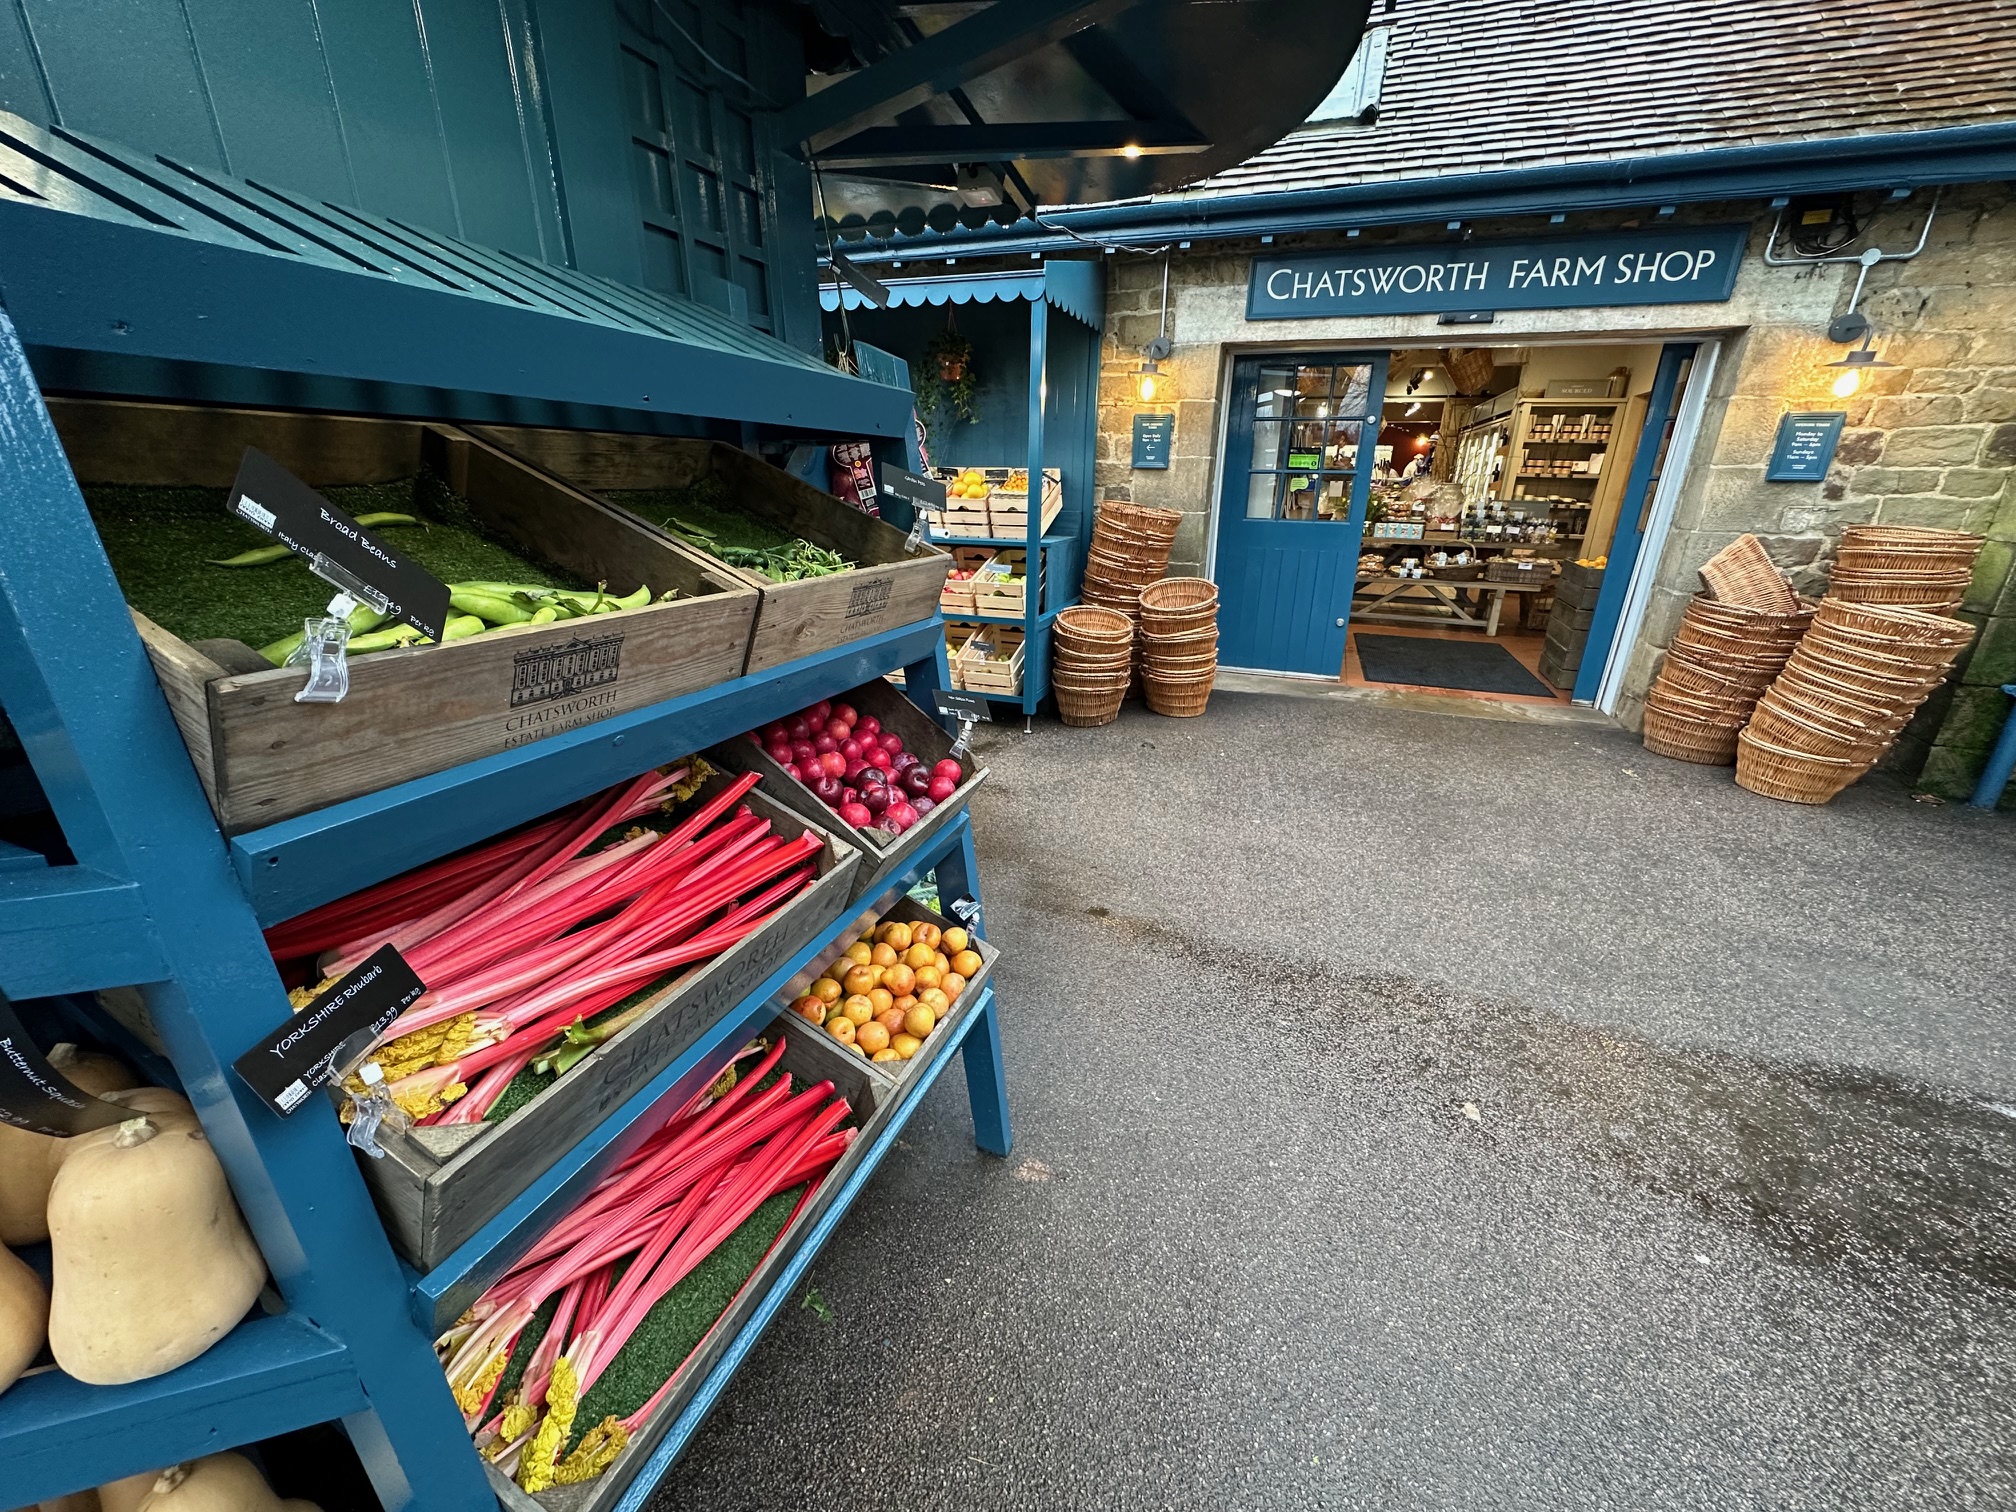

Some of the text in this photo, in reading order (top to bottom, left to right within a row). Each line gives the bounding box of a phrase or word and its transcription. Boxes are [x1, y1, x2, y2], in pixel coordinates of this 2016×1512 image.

[1266, 249, 1716, 300] CHATSWORTH FARM SHOP
[277, 531, 299, 551] Italy
[320, 507, 397, 569] Broad Beans
[363, 585, 402, 615] £1249
[503, 706, 616, 748] ESTATE FARM SHOP
[505, 690, 617, 732] CHATSWORTH
[269, 964, 383, 1059] YORKSHIRE Rhubarb
[369, 1006, 398, 1032] £13.99
[604, 924, 789, 1086] CHATSWORTH
[0, 1036, 87, 1110] Butternut Squash
[303, 1041, 346, 1079] YORKSHIRE
